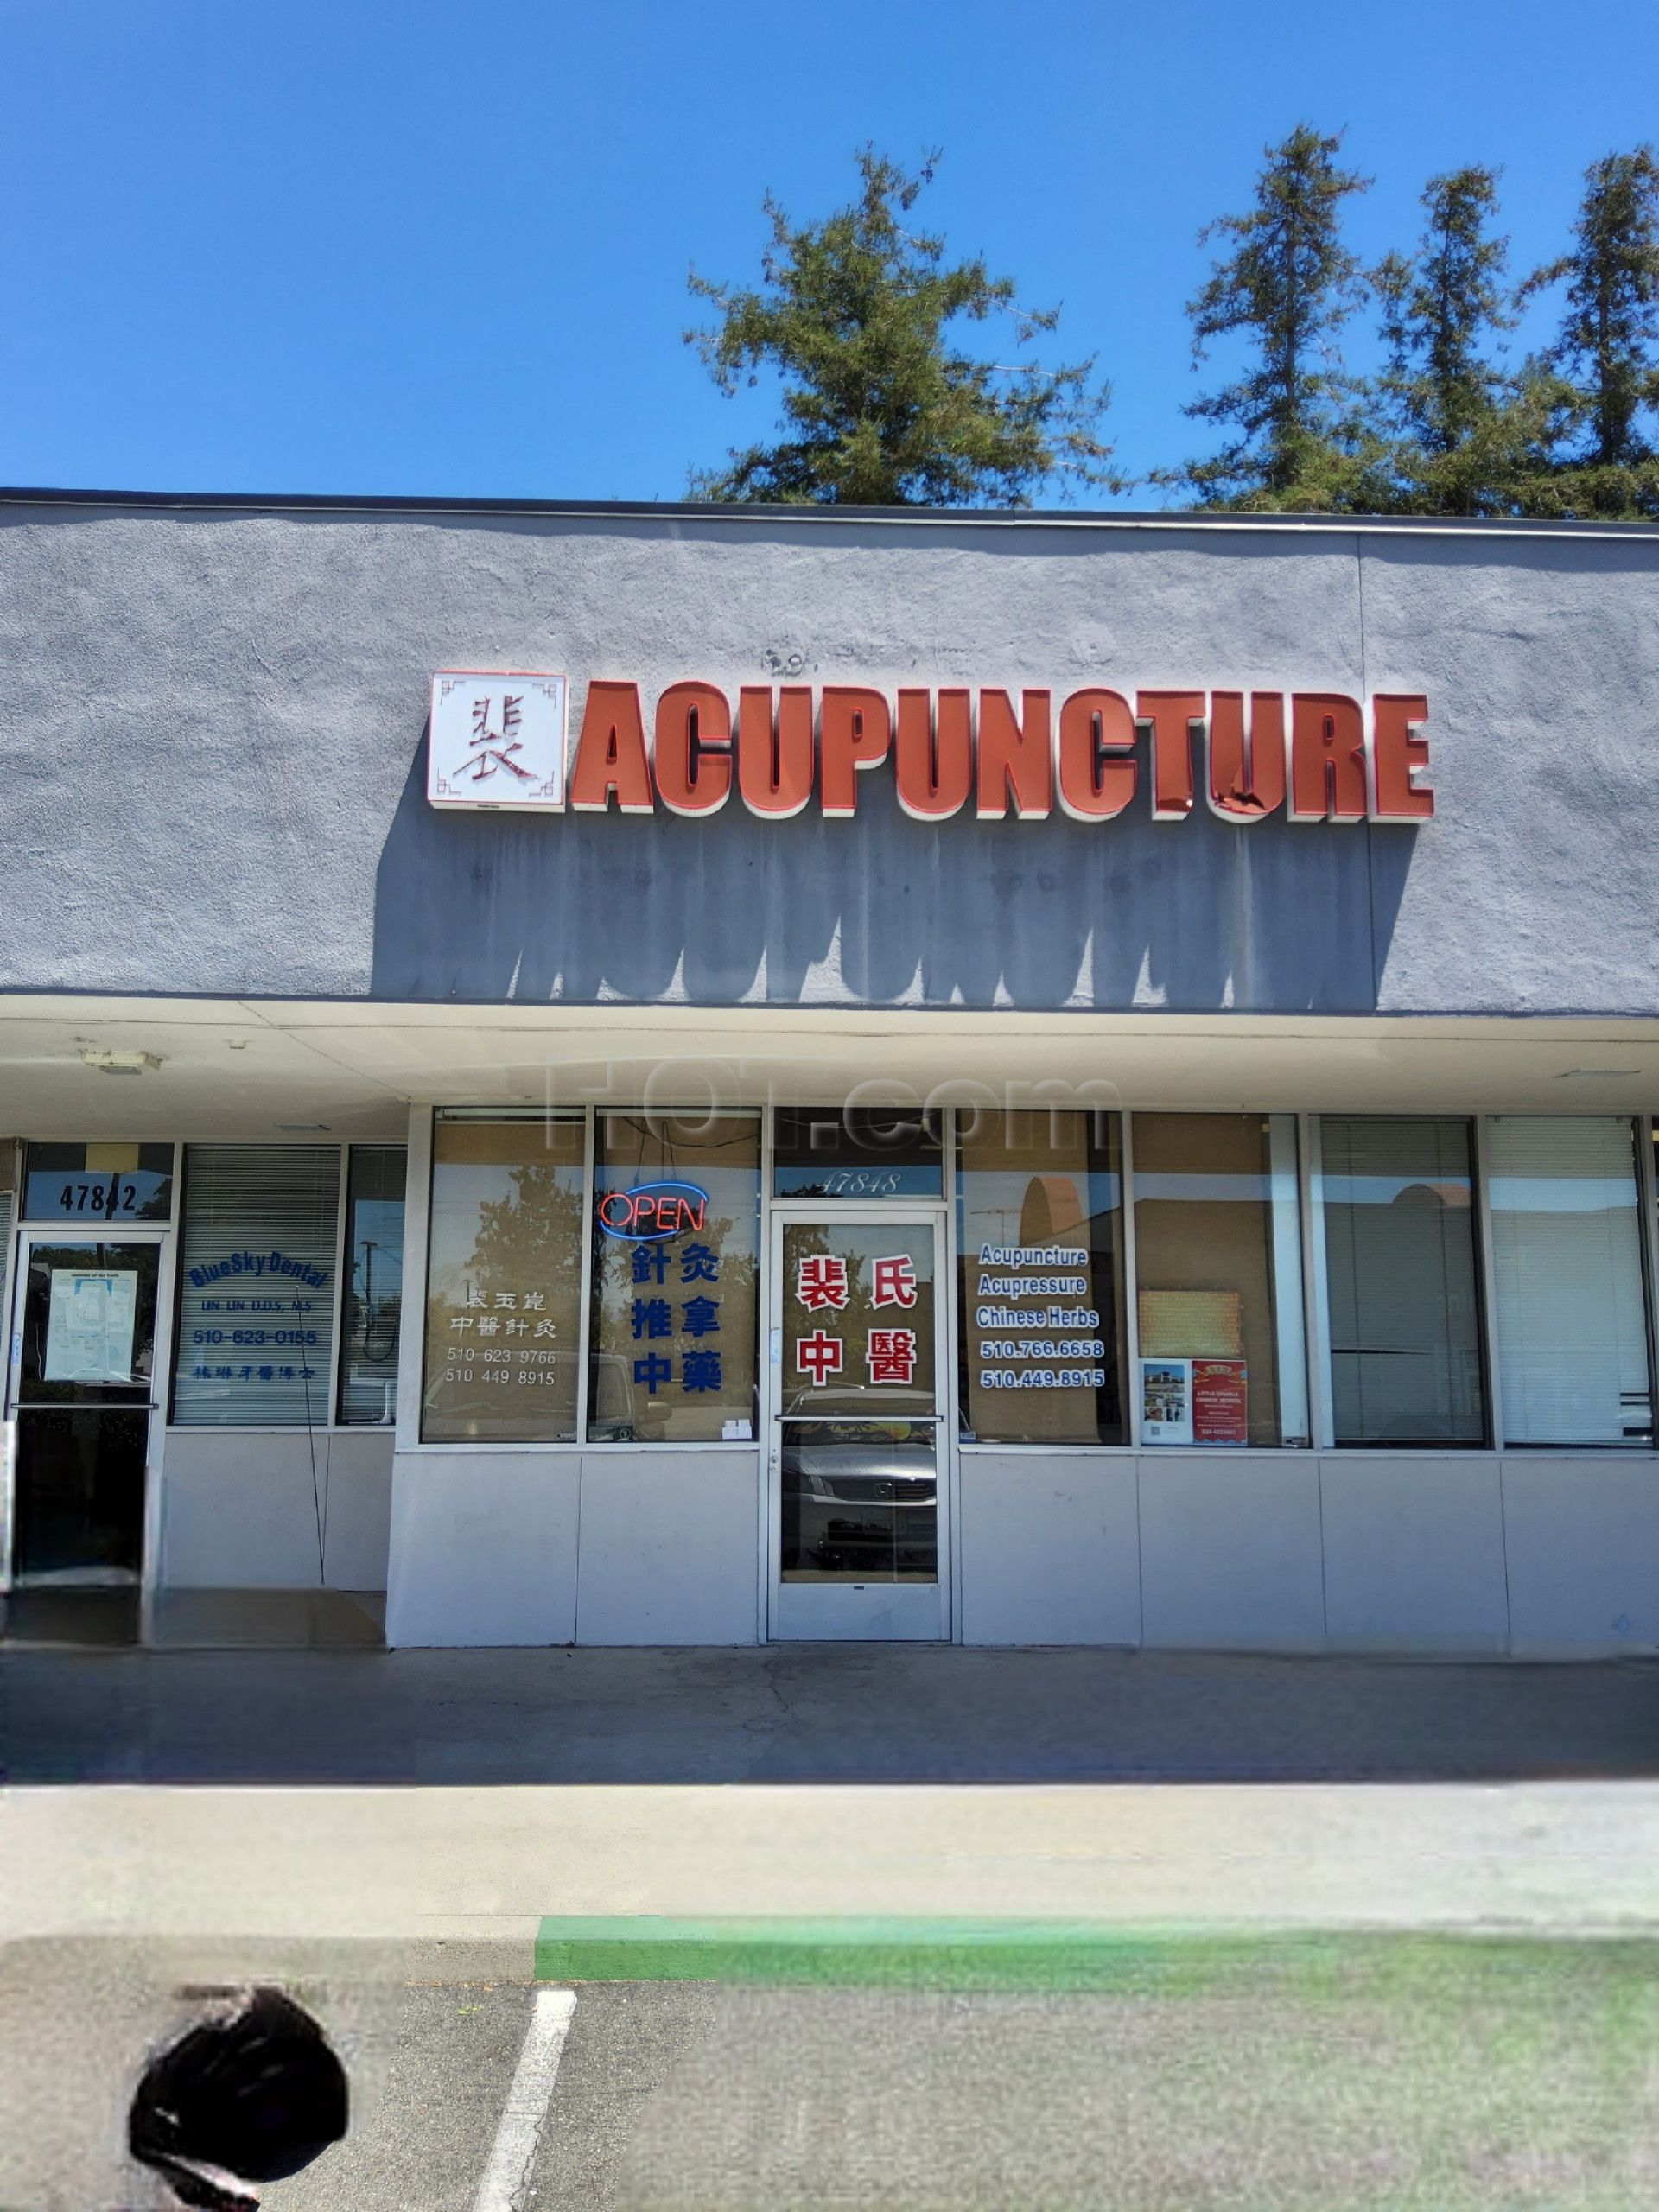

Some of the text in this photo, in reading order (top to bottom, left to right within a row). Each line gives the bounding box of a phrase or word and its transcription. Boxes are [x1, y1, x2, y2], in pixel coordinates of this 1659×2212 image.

[453, 694, 537, 779] 裴
[570, 680, 1434, 821] ACUPUNCTURE
[817, 1172, 901, 1192] 47848
[60, 1185, 137, 1211] 47842
[598, 1193, 707, 1231] OPEN
[631, 1243, 721, 1285] 針灸
[979, 1243, 1088, 1269] Acupuncture
[269, 1251, 328, 1288] Dental
[798, 1255, 917, 1312] 裴氏
[978, 1274, 1086, 1300] Acupressure
[201, 1300, 220, 1311] LIN
[226, 1300, 245, 1311] LIN
[631, 1296, 721, 1341] 推拿
[977, 1306, 1099, 1328] Chinese Herbs
[192, 1330, 318, 1344] 510-623-0155
[981, 1340, 1104, 1359] 510.766.6658
[447, 1347, 556, 1364] 510 623 9766
[797, 1329, 917, 1387] 中醫
[445, 1368, 555, 1386] 510 449 8915
[633, 1351, 722, 1395] 中藥
[981, 1370, 1105, 1389] 510.449.8915
